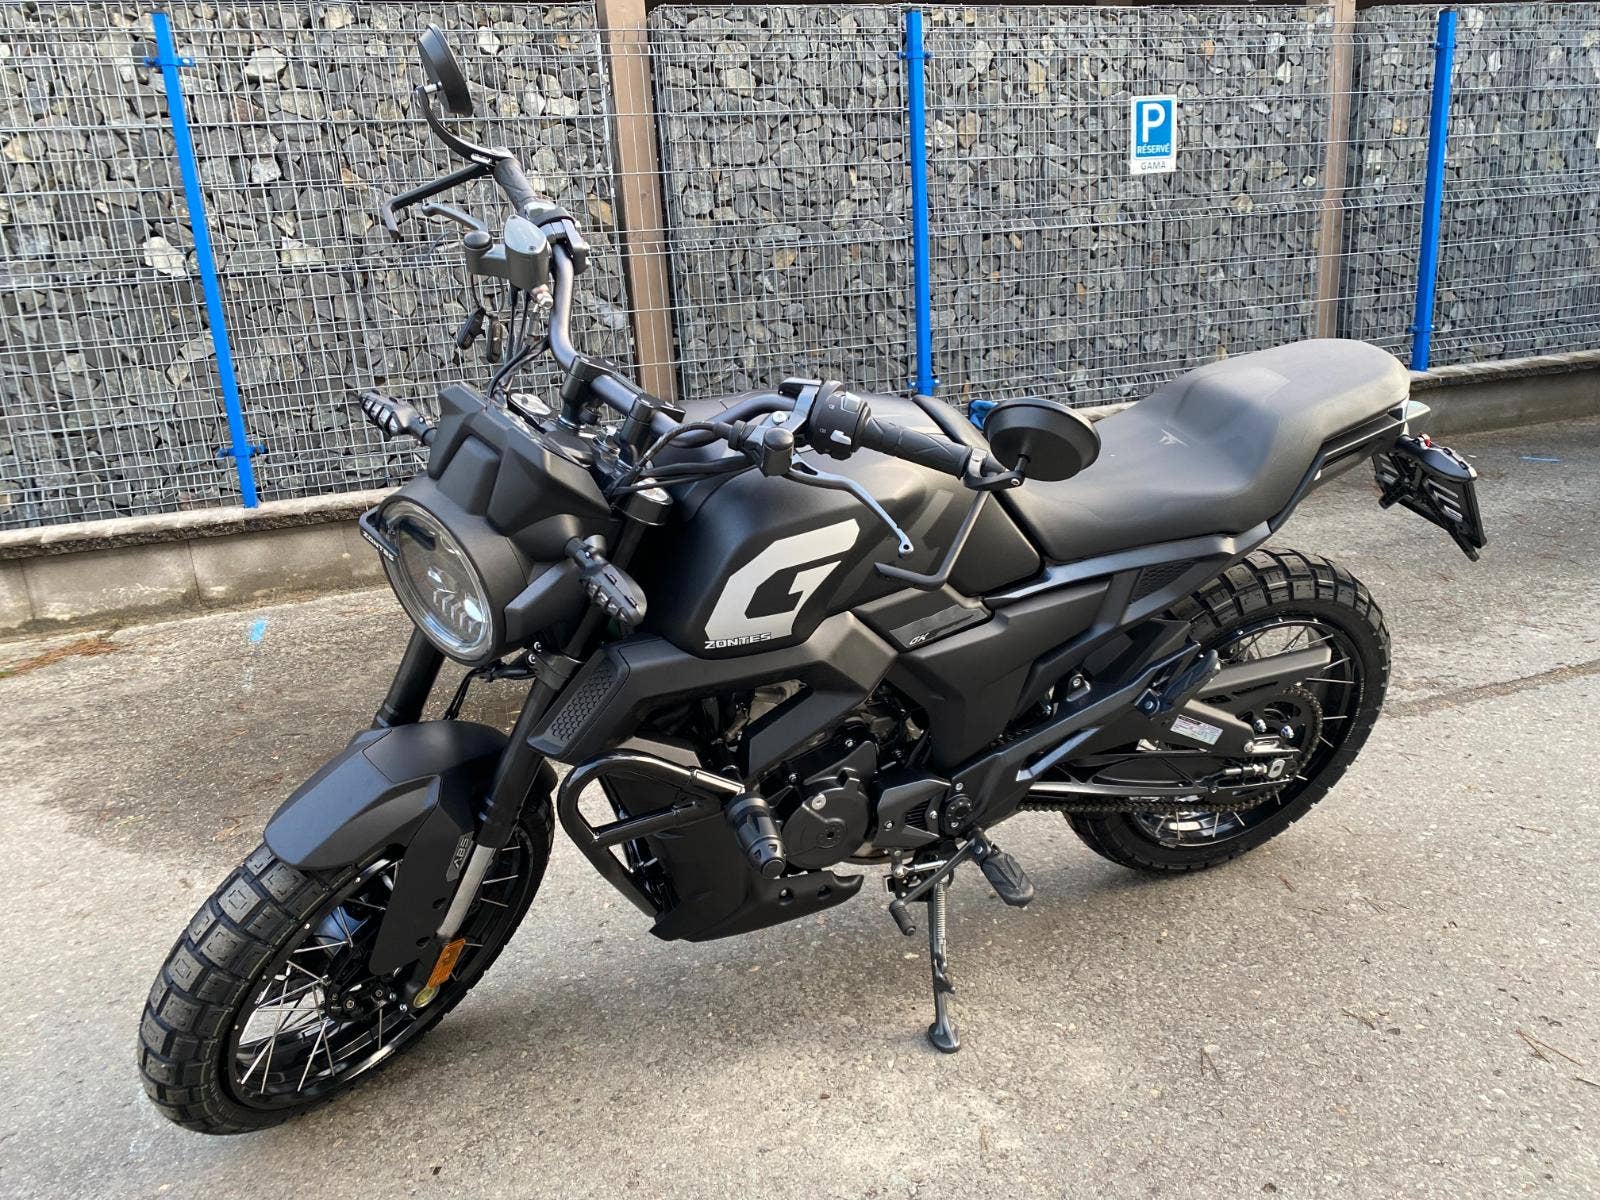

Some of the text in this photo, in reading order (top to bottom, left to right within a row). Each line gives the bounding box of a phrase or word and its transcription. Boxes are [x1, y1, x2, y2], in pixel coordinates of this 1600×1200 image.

[1142, 103, 1166, 143] P
[1136, 143, 1170, 154] RÉSERVÉ
[1140, 160, 1166, 170] GAMA
[704, 633, 771, 649] ZONTES
[453, 838, 469, 869] ABS
